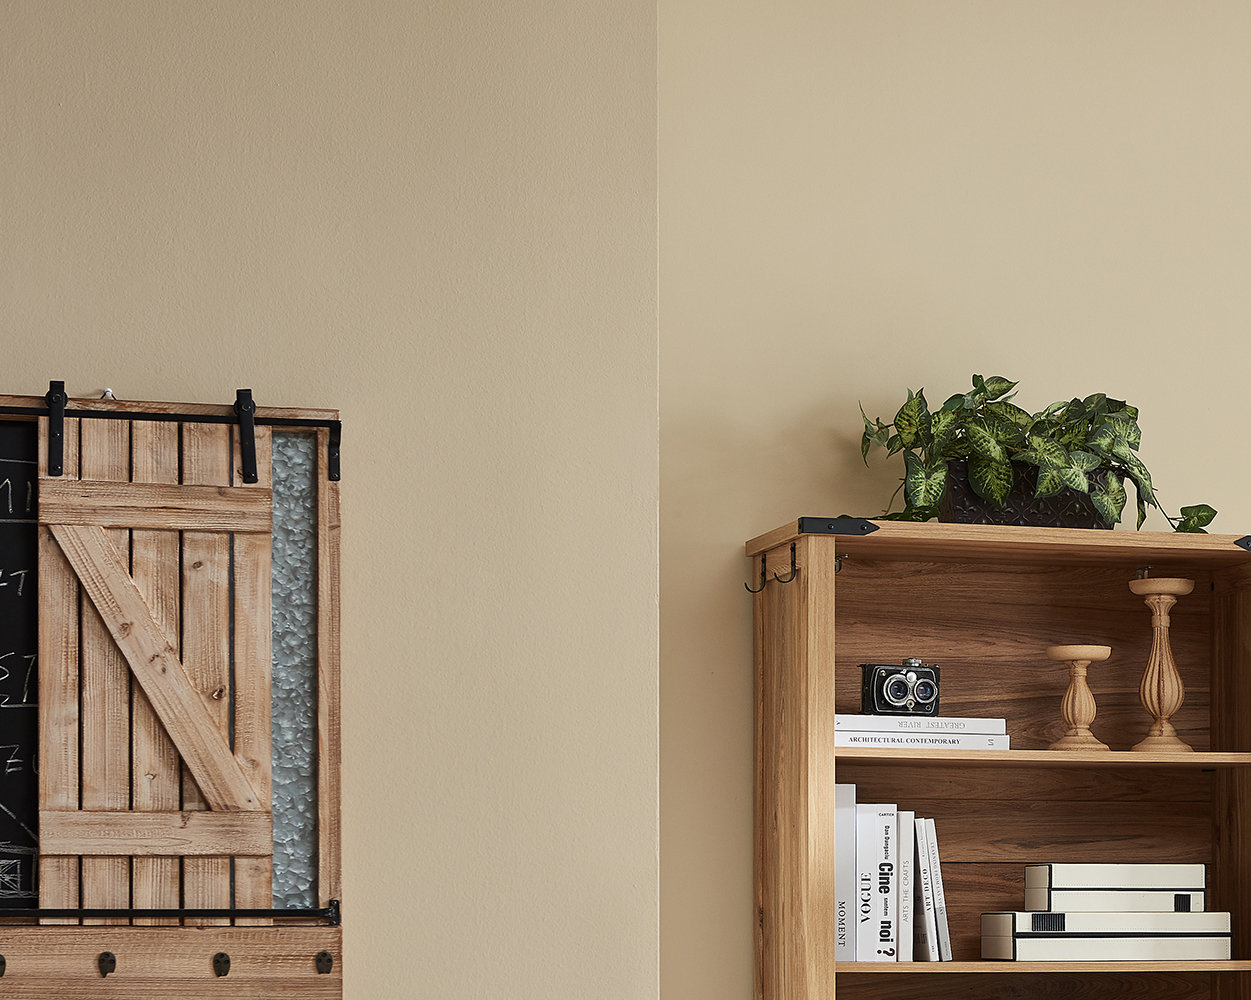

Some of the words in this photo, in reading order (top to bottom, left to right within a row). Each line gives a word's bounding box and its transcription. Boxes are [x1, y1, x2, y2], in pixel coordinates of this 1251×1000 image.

[897, 720, 921, 729] RIVER
[926, 720, 966, 730] GREATEST
[848, 736, 905, 745] ARCHITECTURAL
[905, 737, 961, 746] CONTEMPORARY
[930, 842, 938, 869] LEARNING
[878, 862, 894, 894] Cine
[902, 860, 910, 886] CRAFTS
[922, 868, 930, 892] DECO
[860, 872, 872, 924] VOGUE
[838, 901, 847, 947] MOMENT
[879, 920, 894, 942] noi
